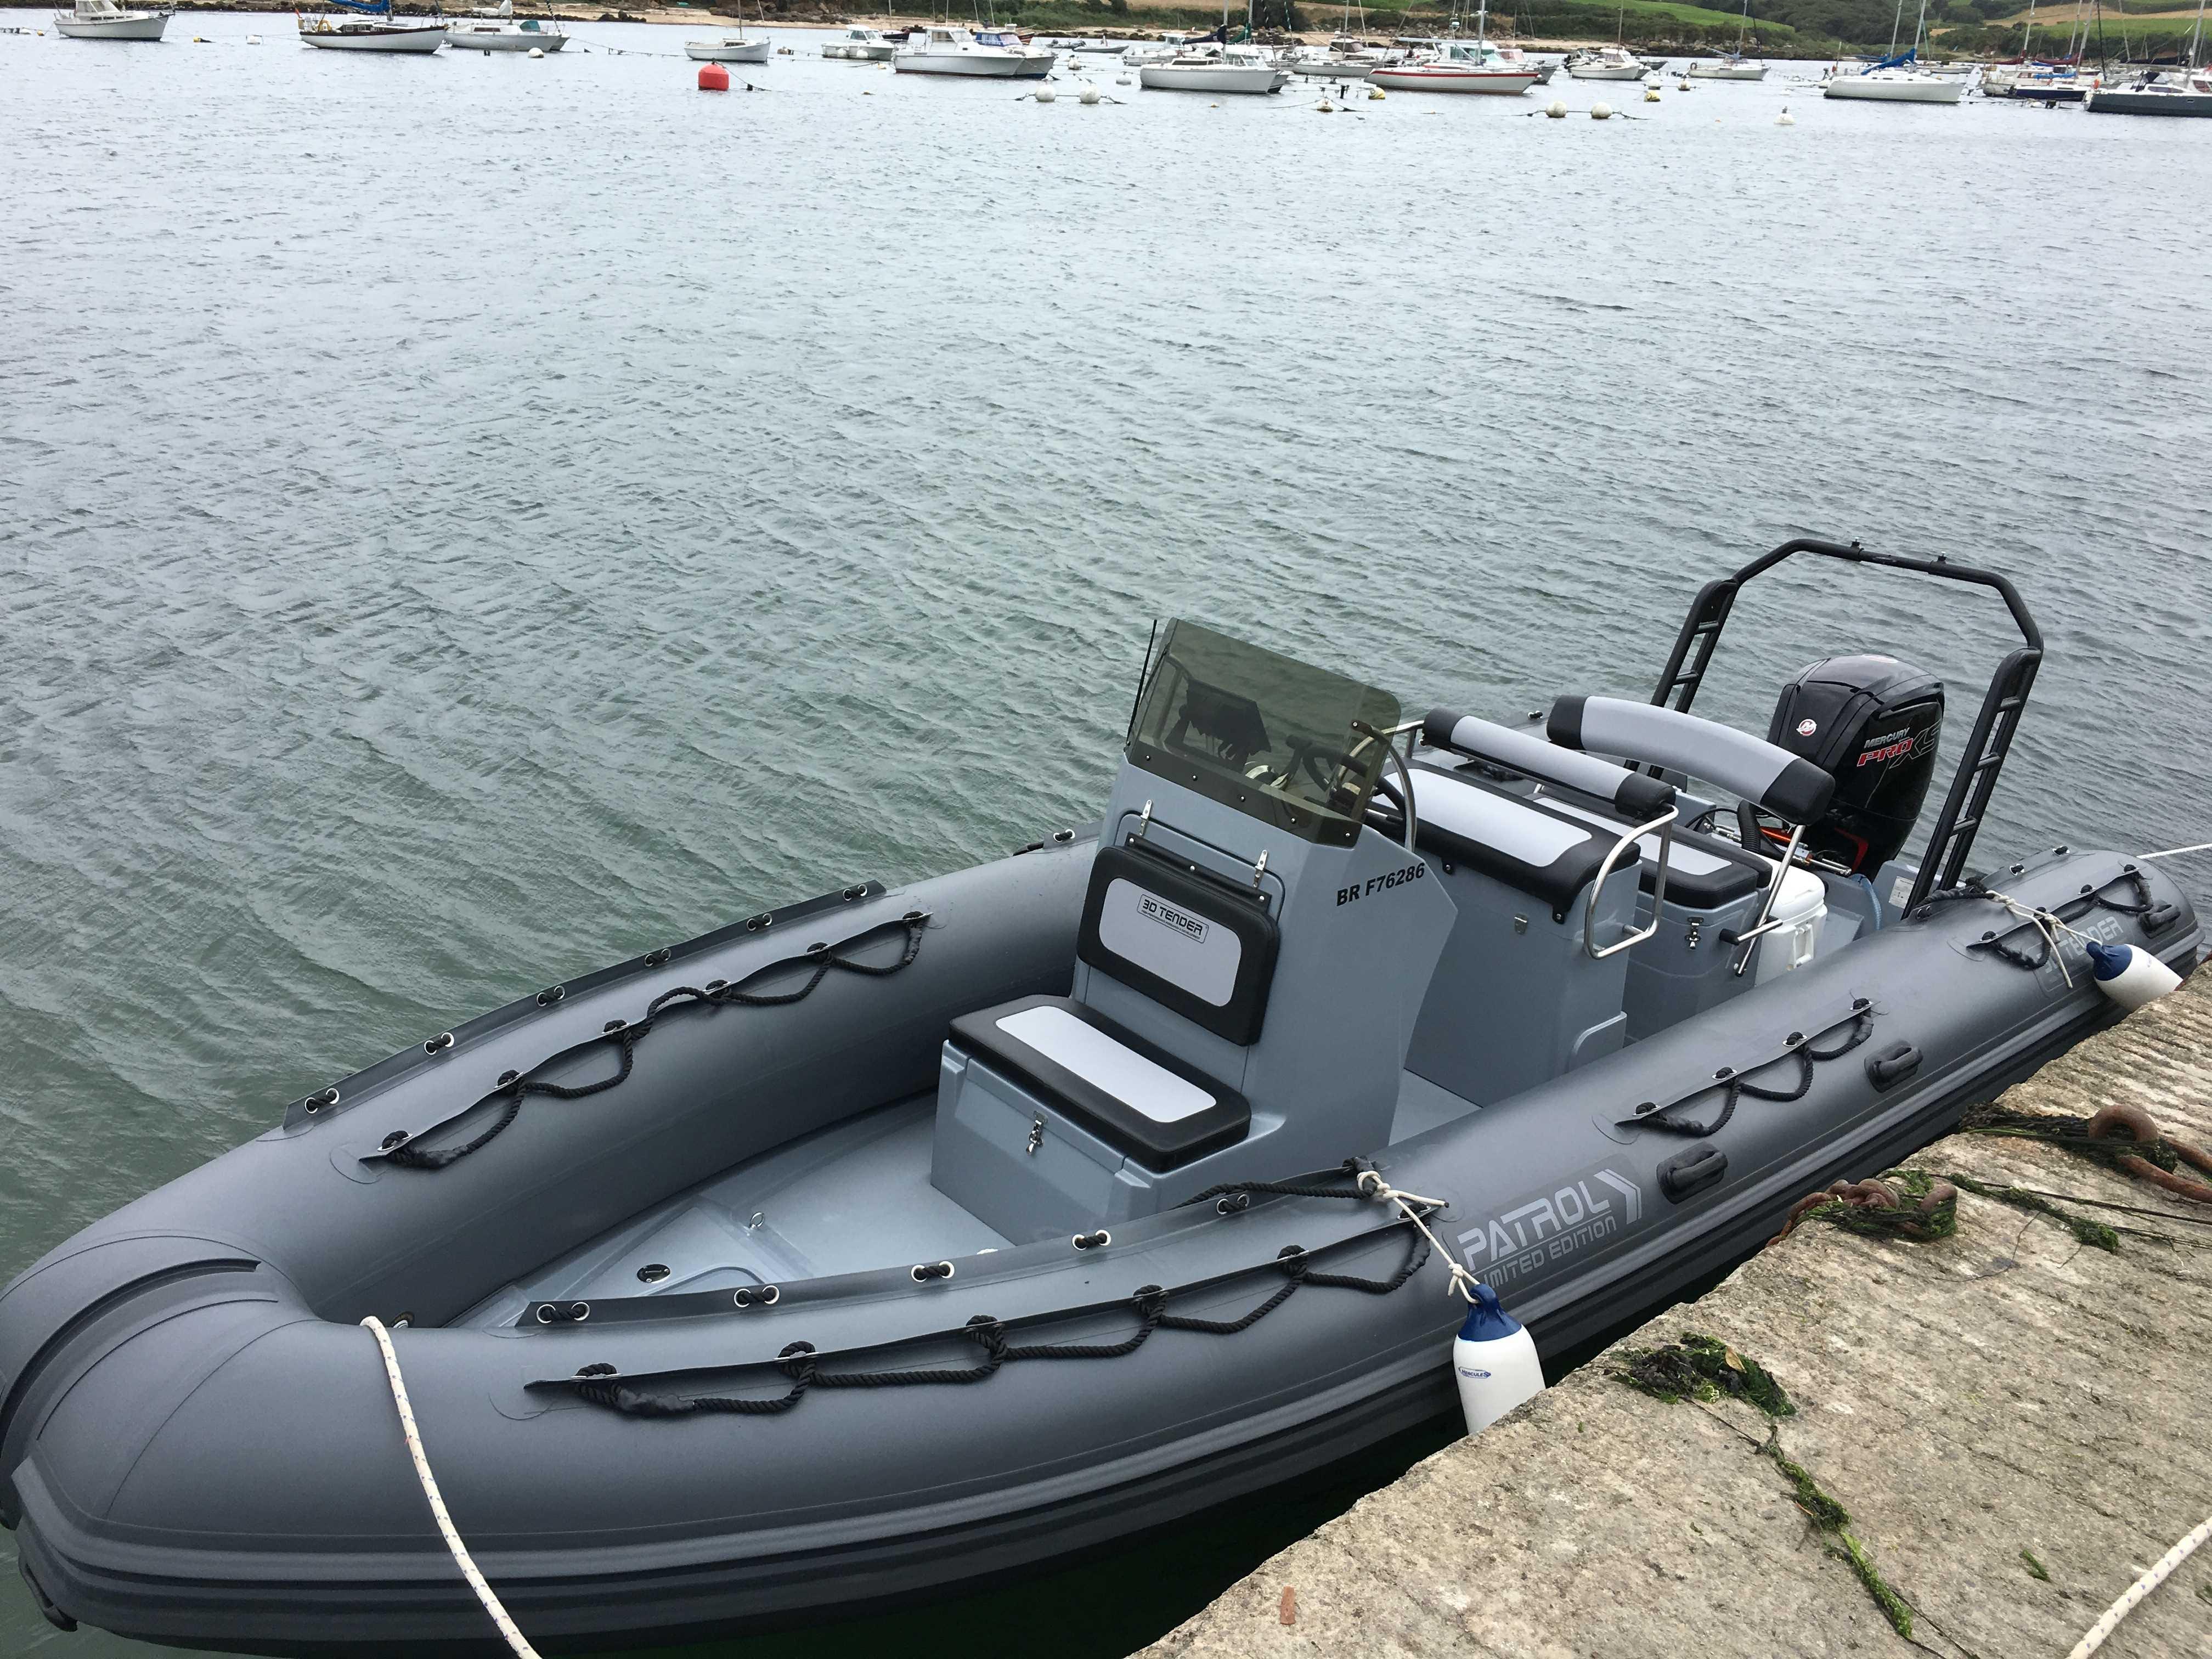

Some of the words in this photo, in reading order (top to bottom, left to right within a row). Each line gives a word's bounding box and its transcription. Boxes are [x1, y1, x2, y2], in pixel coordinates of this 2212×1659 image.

[1857, 738, 1914, 767] PRO
[1864, 727, 1910, 748] MERCURY
[1336, 884, 1360, 906] BR
[1365, 862, 1425, 896] F76286
[1143, 899, 1157, 912] 3D
[1160, 906, 1203, 935] TENDER
[1457, 1181, 1611, 1271] PATROL
[1480, 1249, 1545, 1289] IMITED
[1549, 1216, 1617, 1260] EDITION
